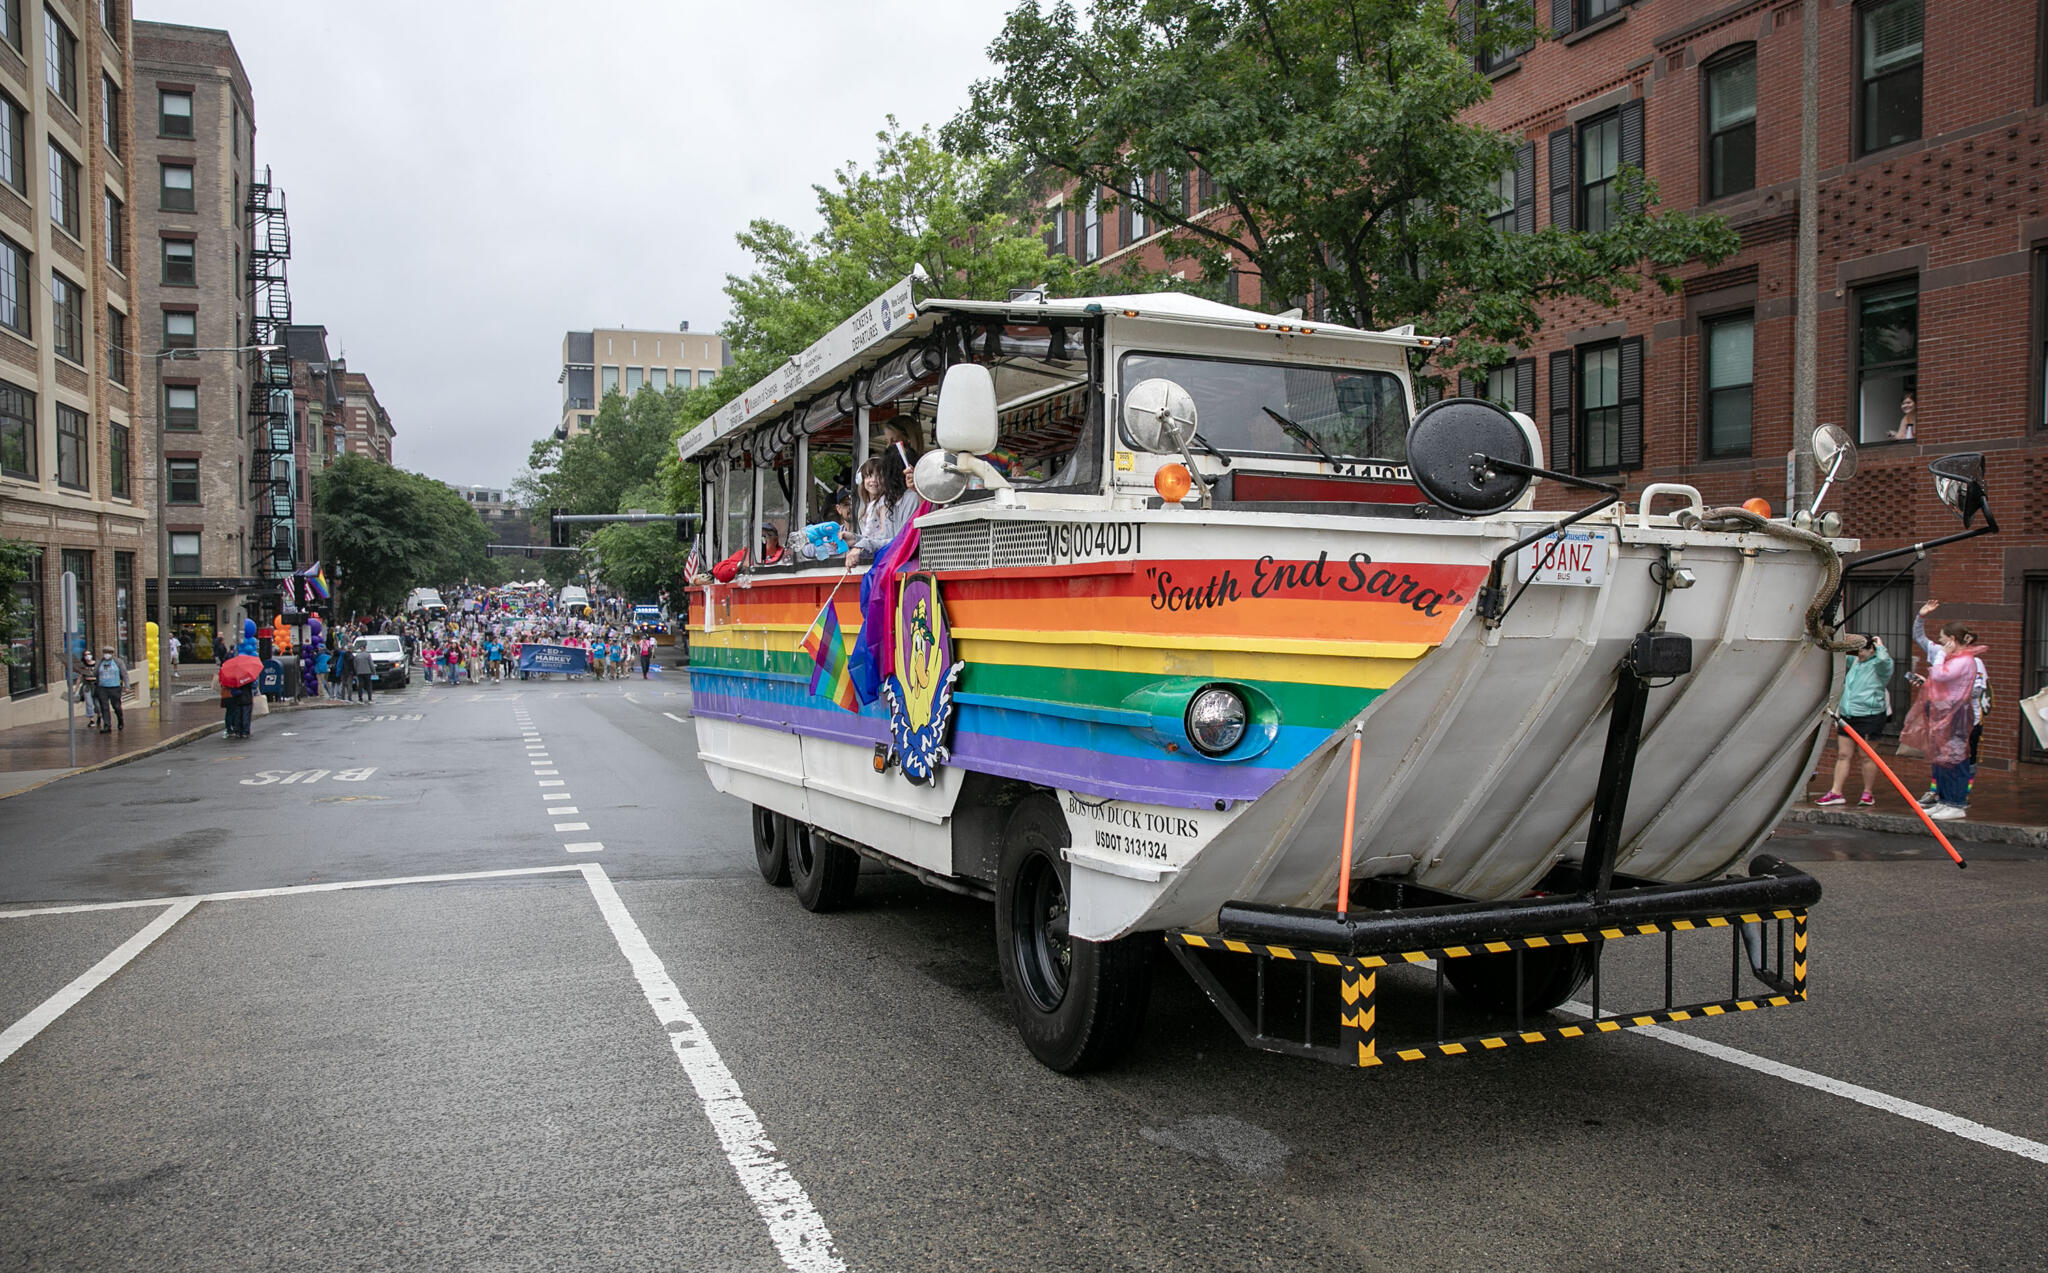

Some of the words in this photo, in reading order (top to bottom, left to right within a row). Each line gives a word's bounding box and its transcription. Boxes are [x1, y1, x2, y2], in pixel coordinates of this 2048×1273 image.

[852, 311, 869, 332] TICKETS
[852, 323, 878, 351] DEPARTURES
[1532, 541, 1593, 572] 18ANZ
[1146, 567, 1241, 612] "South
[1251, 550, 1331, 598] End
[1338, 552, 1463, 617] Sara"
[1557, 573, 1571, 581] BUS
[535, 655, 571, 663] MARKEY
[239, 767, 379, 785] BUS
[1069, 798, 1105, 820] BOSTON
[1108, 806, 1142, 829] DUCK
[1145, 813, 1198, 838] TOURS
[1096, 830, 1122, 852] USDOT
[1125, 836, 1167, 861] 3131324
